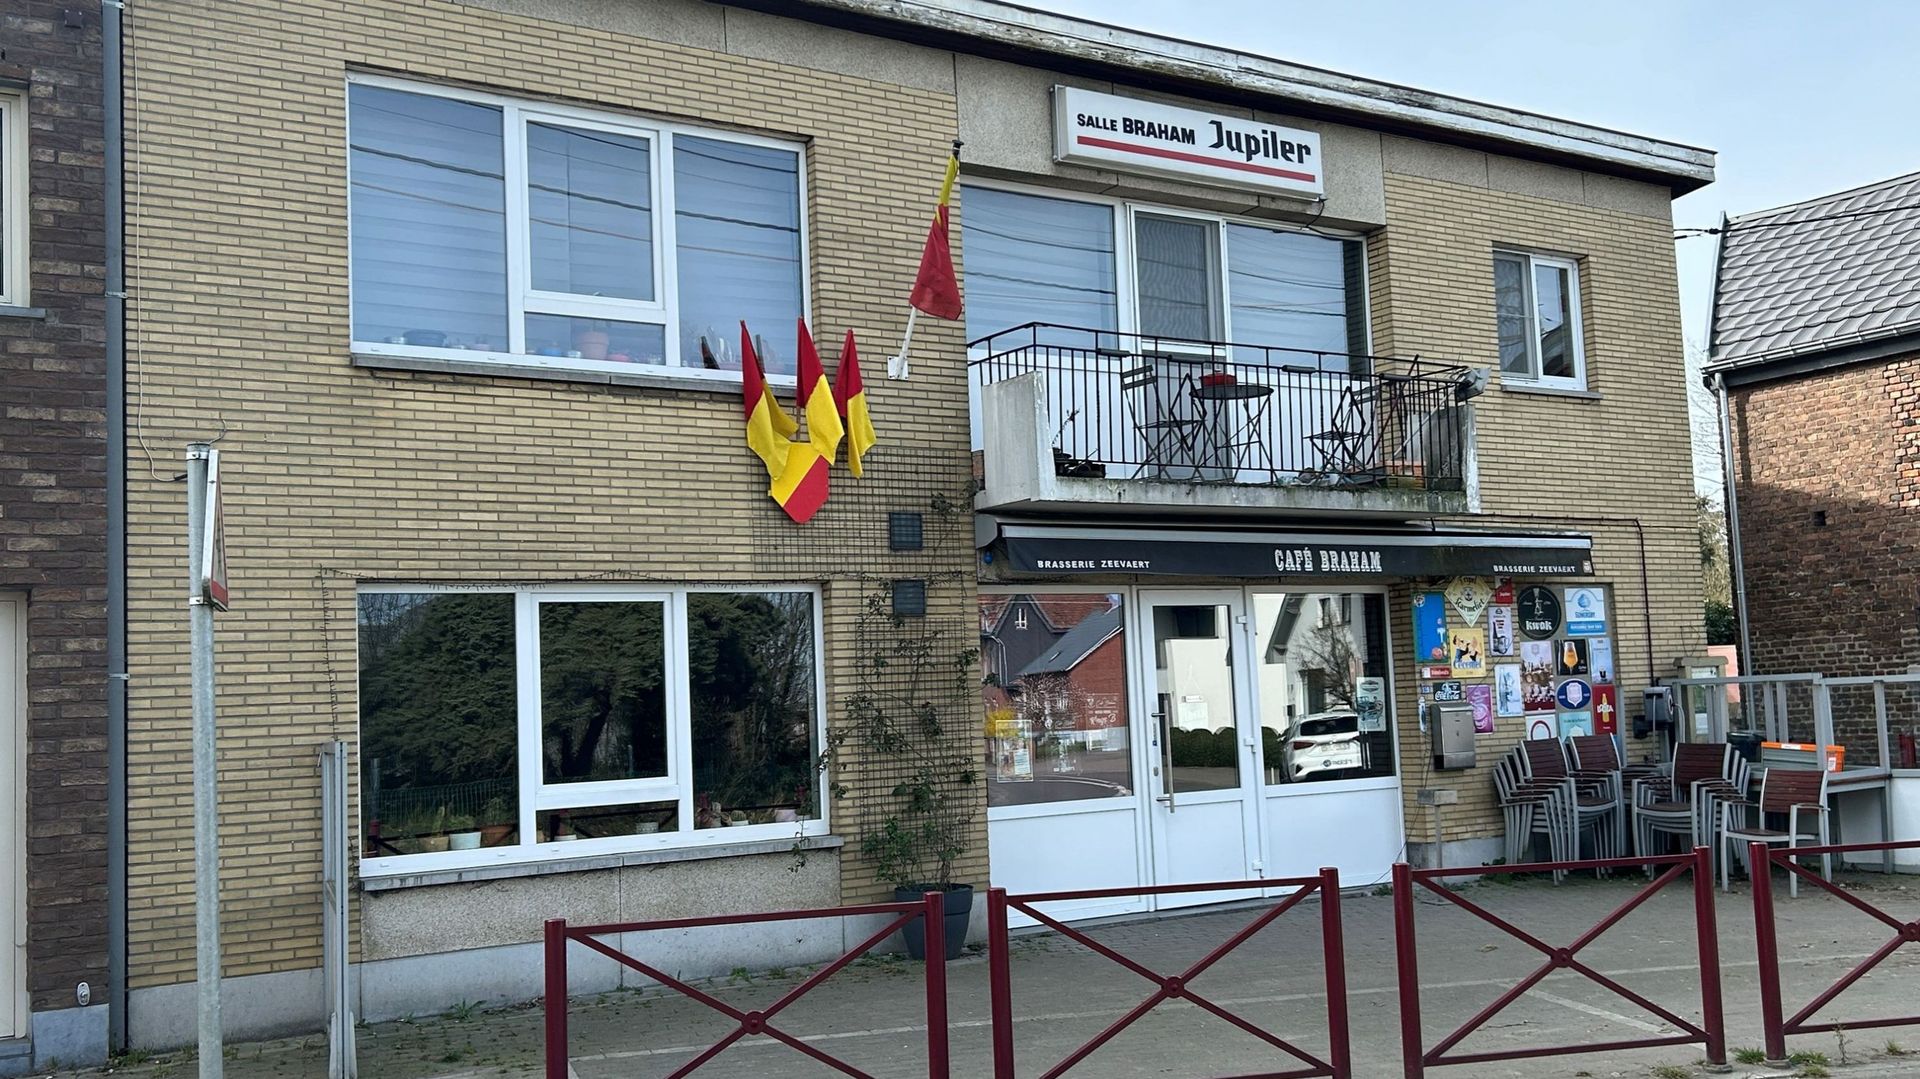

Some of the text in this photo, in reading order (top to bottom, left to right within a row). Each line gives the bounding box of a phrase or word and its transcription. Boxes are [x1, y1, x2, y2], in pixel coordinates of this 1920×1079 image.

[1077, 113, 1196, 145] SALLE BRAHAM
[1208, 119, 1312, 164] Jupiler
[1036, 559, 1150, 570] BRASSERIE ZEEVAERT
[1274, 546, 1382, 573] CAFÉ BRAHAM
[1493, 564, 1537, 574] BRASSERIE
[1539, 565, 1577, 574] ZEEVAERT
